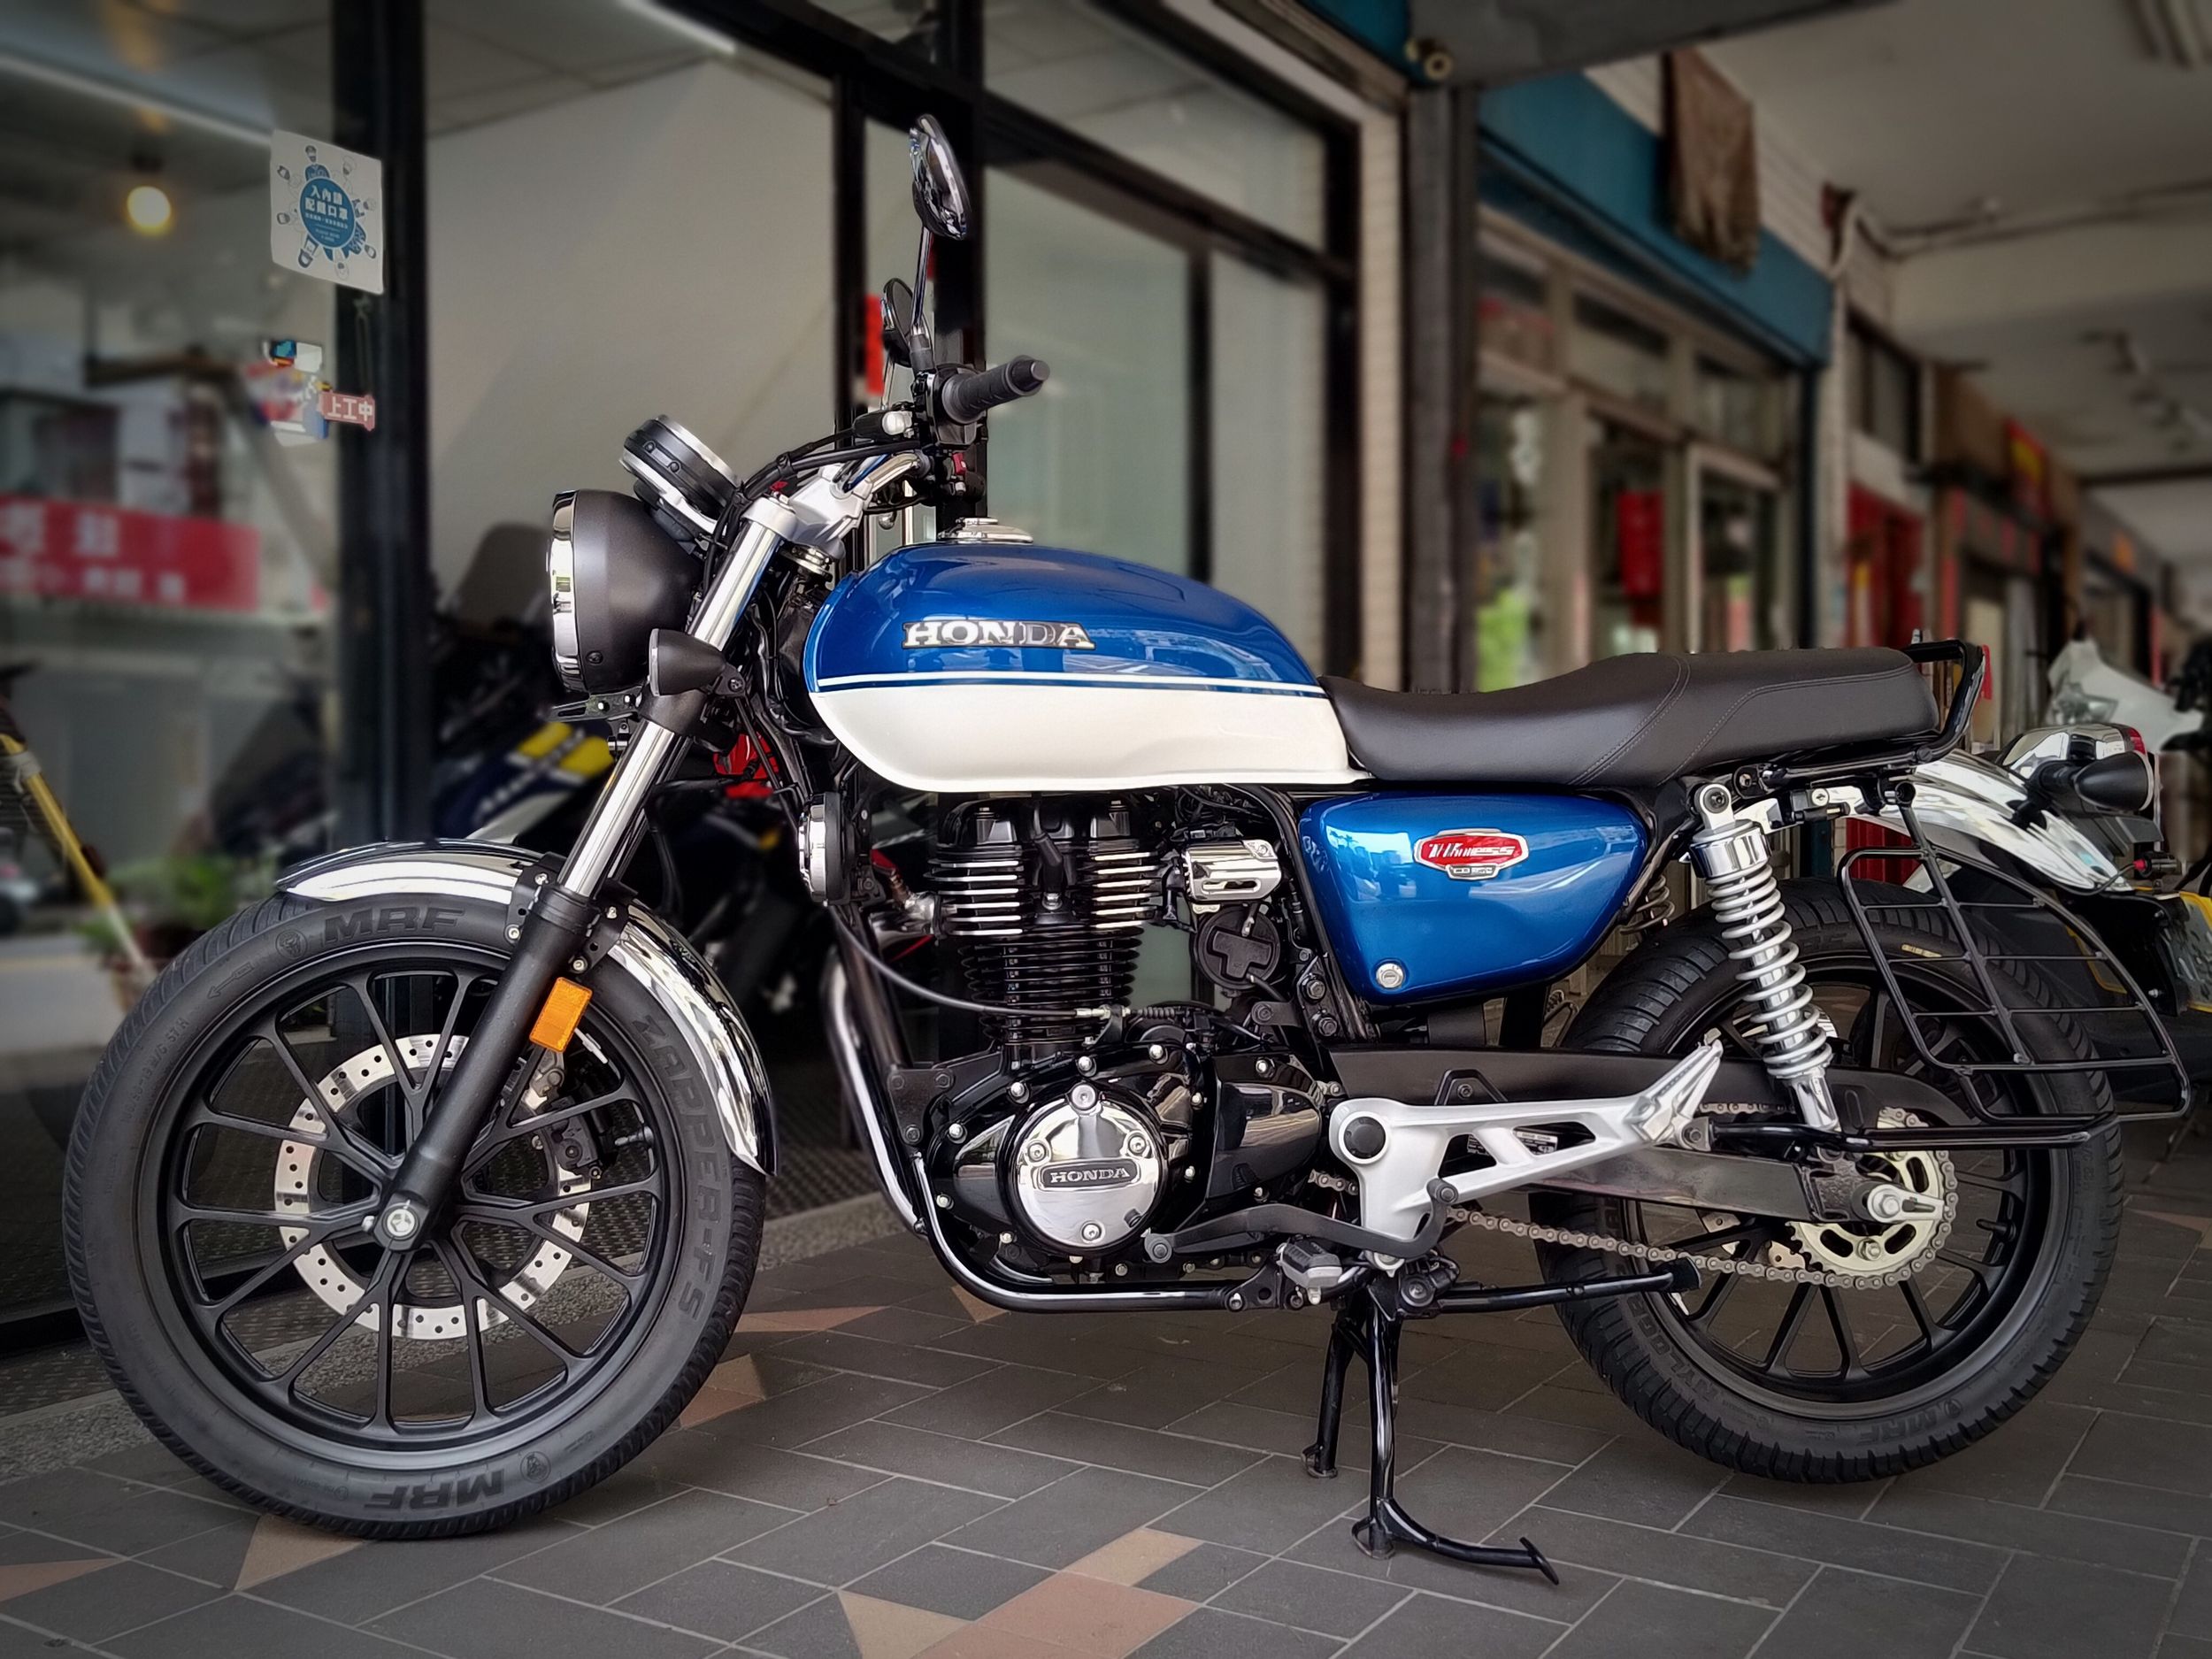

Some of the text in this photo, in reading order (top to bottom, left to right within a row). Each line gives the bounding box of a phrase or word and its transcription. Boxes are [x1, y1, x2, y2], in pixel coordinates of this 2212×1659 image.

[327, 396, 373, 421] 上工中
[903, 621, 1095, 649] HONDA
[324, 907, 465, 945] MRF
[1050, 1167, 1130, 1183] HONDA
[364, 1468, 503, 1509] MRF
